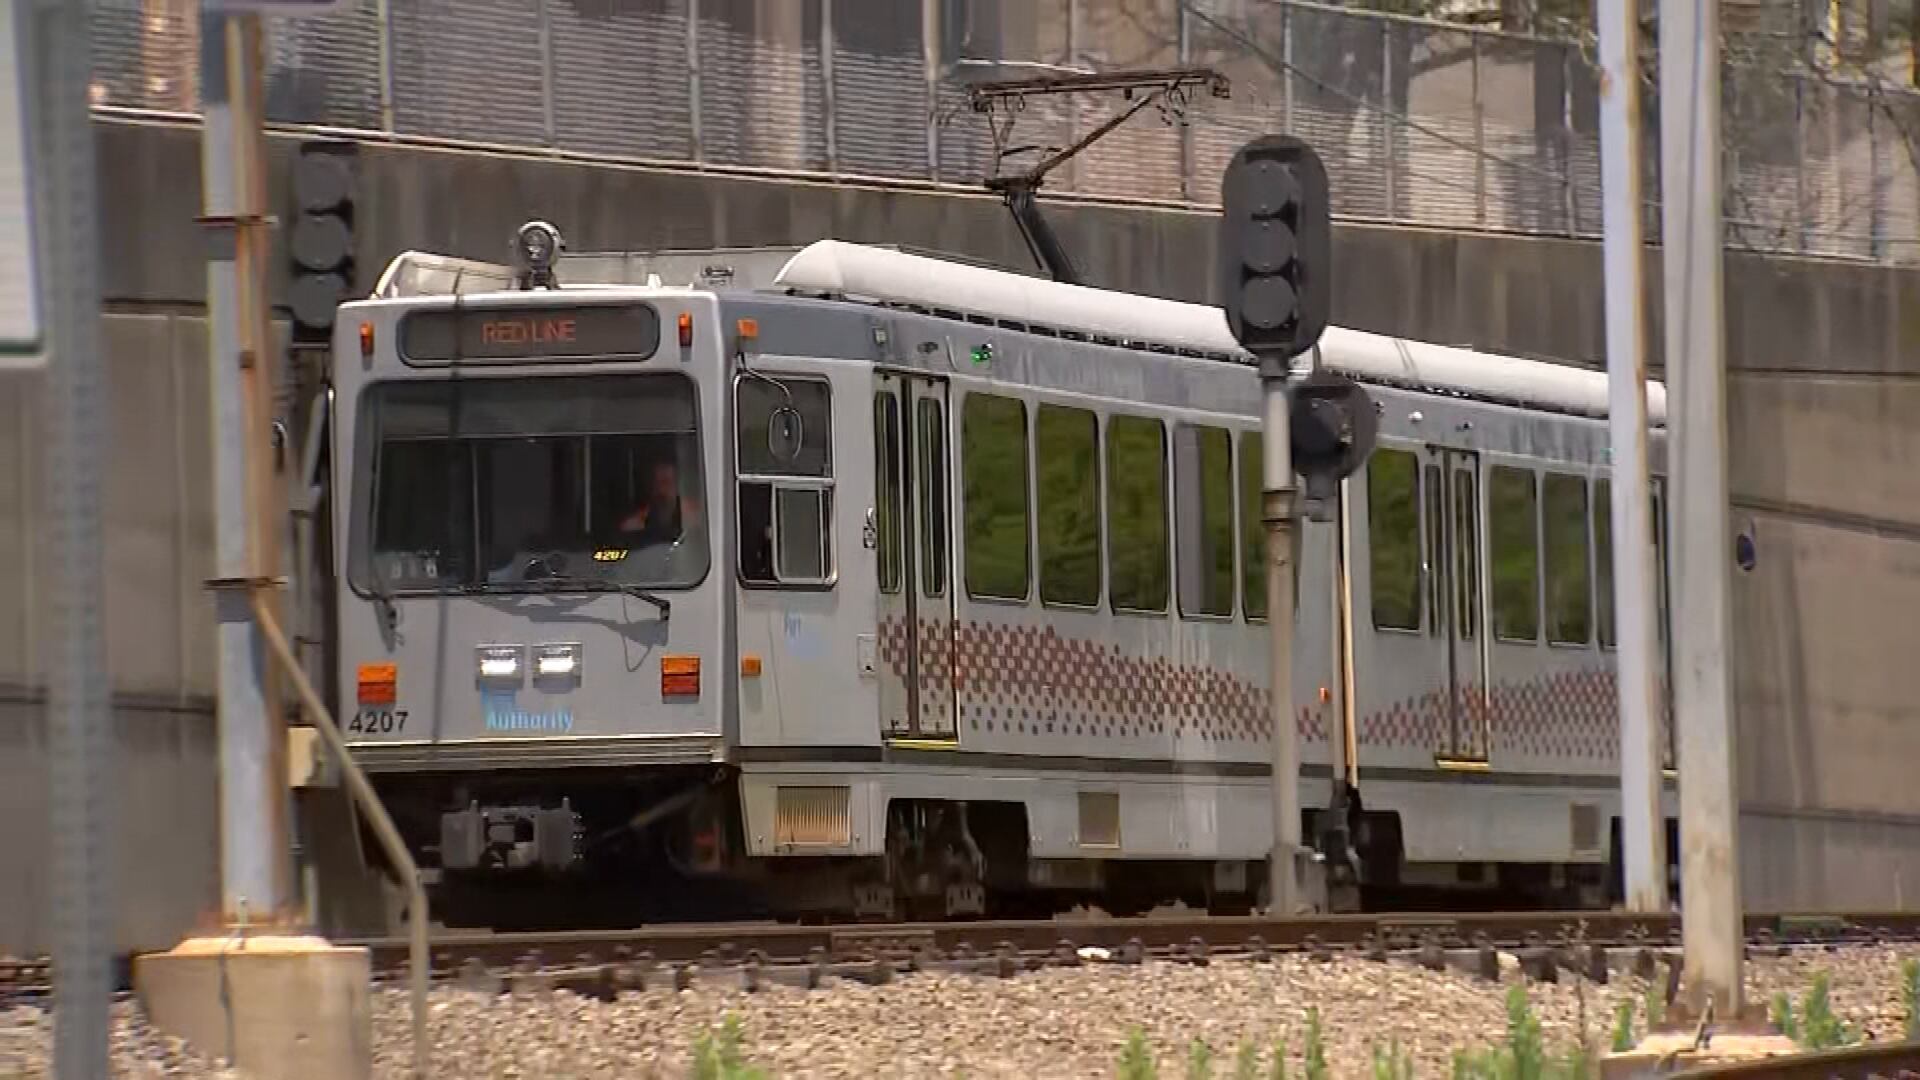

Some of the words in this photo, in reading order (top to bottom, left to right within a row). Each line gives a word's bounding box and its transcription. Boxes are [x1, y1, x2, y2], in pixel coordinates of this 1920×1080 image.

[482, 321, 528, 344] RED
[532, 319, 577, 342] LINE
[593, 549, 628, 561] 4207
[349, 711, 409, 734] 4207
[485, 709, 574, 732] Authority
